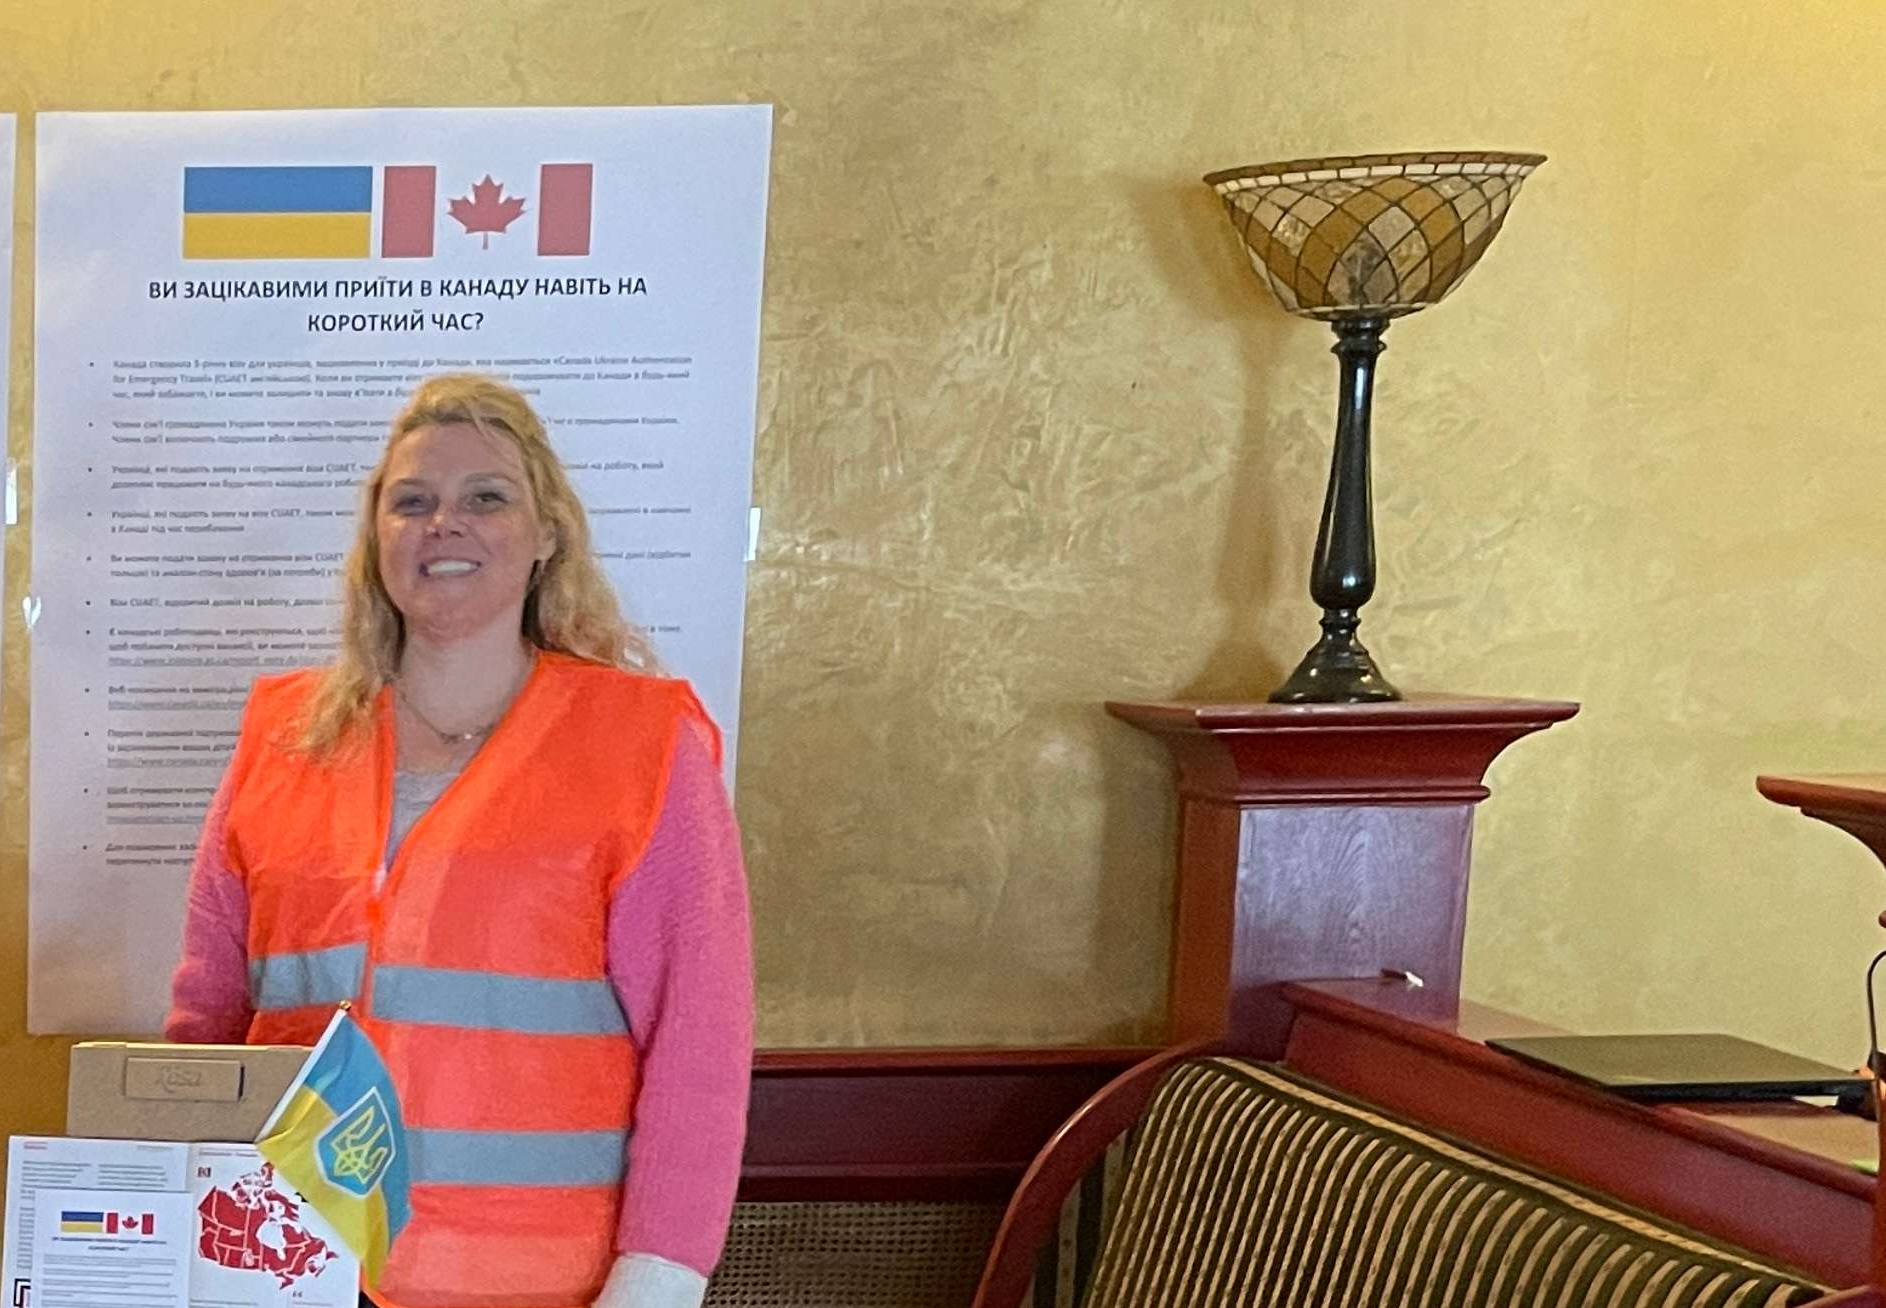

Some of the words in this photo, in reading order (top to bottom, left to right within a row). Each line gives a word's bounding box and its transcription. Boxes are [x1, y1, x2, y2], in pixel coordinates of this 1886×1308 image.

[149, 281, 177, 299] ВИ
[184, 279, 328, 301] ЗАЦІКАВИМИ
[335, 275, 412, 298] ПРИЇТИ
[420, 280, 432, 298] В
[440, 279, 529, 300] КАНАДУ
[535, 278, 611, 296] НАВІТЬ
[618, 277, 647, 295] НА
[308, 309, 424, 332] КОРОТКИЙ
[432, 312, 484, 331] ЧАС?
